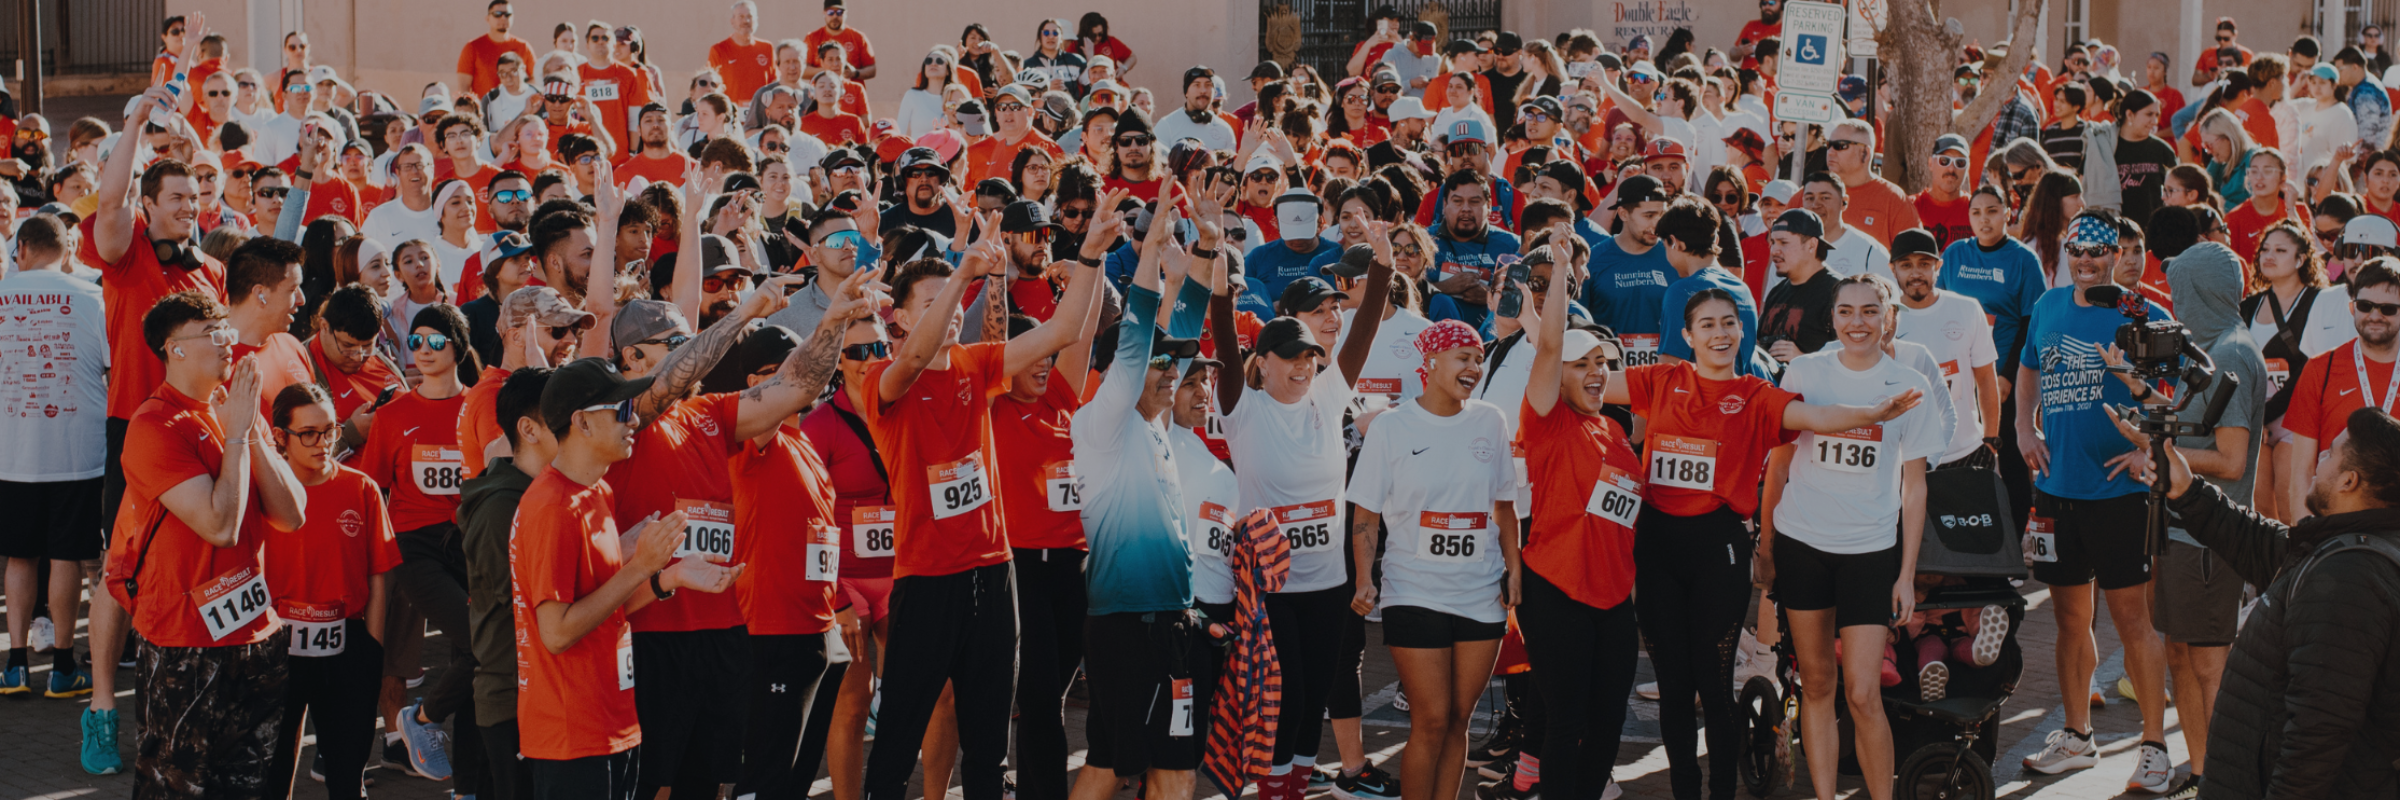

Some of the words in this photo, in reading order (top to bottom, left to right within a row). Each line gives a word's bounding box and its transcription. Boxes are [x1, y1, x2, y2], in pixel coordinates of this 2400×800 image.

[1612, 1, 1655, 23] Double
[1656, 0, 1697, 24] Eagle
[1789, 7, 1840, 21] RESERVED
[1793, 20, 1834, 34] PARKING
[591, 86, 612, 97] 818
[1796, 99, 1815, 108] VAN
[1785, 107, 1824, 118] ACCESSIBLE
[1614, 270, 1651, 281] Running
[1957, 272, 1993, 281] Numbers
[1960, 265, 1992, 275] Running
[1615, 278, 1655, 289] Numbers
[1625, 351, 1658, 367] 686
[2067, 354, 2087, 370] THE
[2062, 369, 2106, 387] COUNTRY
[2089, 385, 2105, 401] 5K
[1661, 440, 1676, 449] RACE
[1682, 443, 1706, 453] RESULT
[422, 450, 439, 458] RACE
[1818, 440, 1877, 468] 1136
[939, 467, 957, 478] RACE
[1655, 457, 1710, 484] 1188
[944, 477, 983, 510] 925
[687, 506, 705, 516] RACE
[711, 508, 730, 518] RESULT
[1602, 490, 1636, 520] 607
[863, 511, 880, 520] RACE
[1431, 517, 1448, 525] RACE
[684, 526, 732, 555] 1066
[1287, 523, 1330, 550] 665
[1429, 534, 1476, 557] 856
[204, 584, 223, 598] RACE
[230, 567, 251, 586] RESULT
[207, 582, 267, 630] 1146
[289, 607, 306, 615] RACE
[315, 608, 339, 617] RESULT
